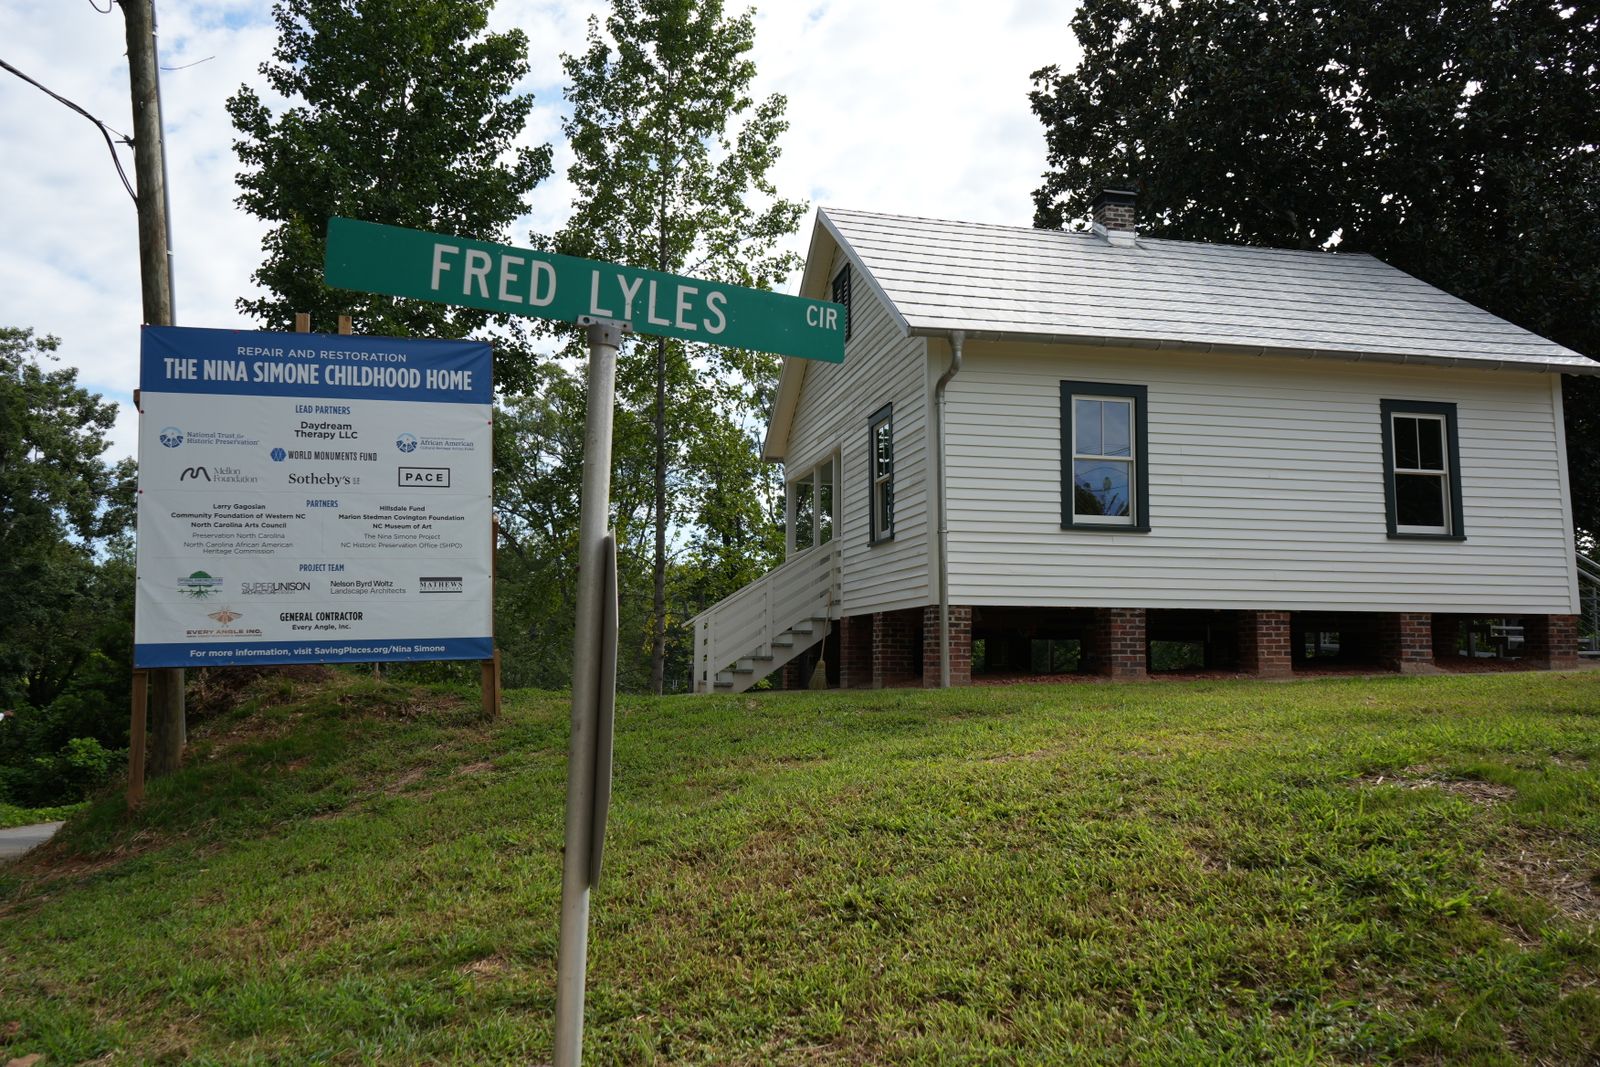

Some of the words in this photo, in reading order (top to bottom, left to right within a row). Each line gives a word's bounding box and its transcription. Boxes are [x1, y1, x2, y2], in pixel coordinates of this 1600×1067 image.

[431, 243, 557, 307] FRED
[589, 270, 727, 335] LYLES
[806, 304, 838, 331] CIR
[237, 346, 283, 357] REPAIR
[288, 349, 315, 358] AND
[320, 351, 407, 363] RESTORATION
[164, 358, 197, 380] THE
[203, 360, 248, 382] NINA
[253, 362, 319, 385] SIMONE
[325, 364, 420, 389] CHILDHOOD
[426, 369, 472, 391] HOME
[295, 405, 313, 414] LEAD
[315, 405, 351, 415] PARTNERS
[300, 421, 352, 431] Daydream
[294, 430, 336, 440] Therapy
[339, 431, 358, 439] LLC
[288, 451, 312, 460] WORLD
[314, 451, 357, 461] MONUMENTS
[360, 453, 377, 461] FUND
[214, 467, 240, 475] Mellon
[214, 474, 258, 483] Foundation
[406, 473, 443, 482] PACE
[306, 500, 338, 508] PARTNERS
[299, 564, 326, 572] PROJECT
[328, 564, 345, 572] TEAM
[280, 612, 313, 622] GENERAL
[315, 611, 363, 621] CONTRACTOR
[208, 649, 233, 657] more
[235, 648, 291, 656] information,
[293, 647, 312, 655] visit
[314, 645, 412, 656] SavingPlaces.org/Nina
